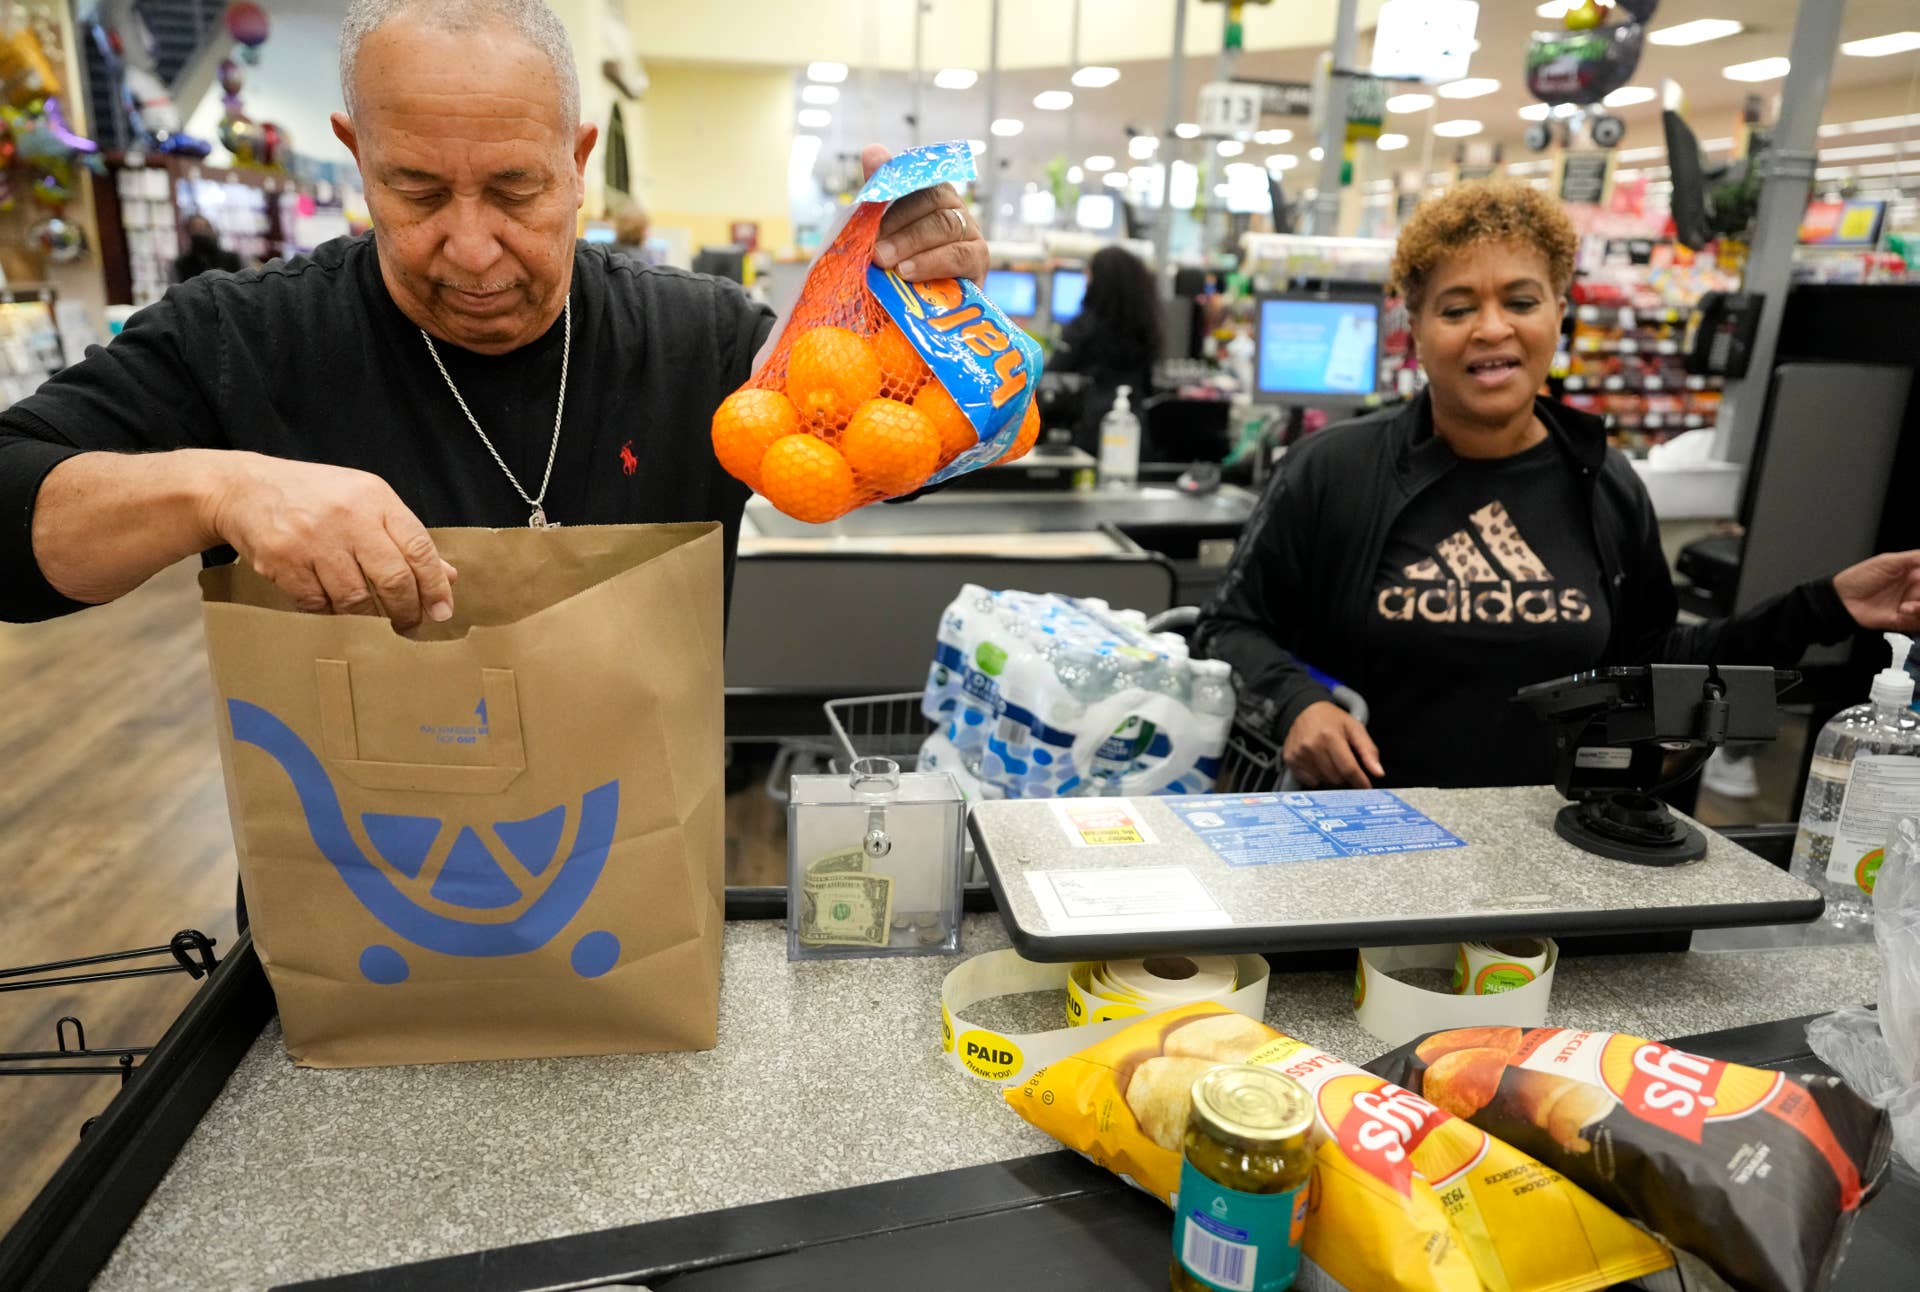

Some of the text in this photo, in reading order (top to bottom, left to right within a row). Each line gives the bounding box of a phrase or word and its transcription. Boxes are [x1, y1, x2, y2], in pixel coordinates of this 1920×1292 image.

[912, 277, 1028, 409] halo
[1377, 578, 1592, 624] adidas
[1067, 992, 1082, 1017] AID
[966, 1041, 1014, 1065] PAID
[1554, 1030, 1592, 1064] ECUE
[966, 1059, 1012, 1079] THANK YOU!
[1285, 1053, 1342, 1079] LASS
